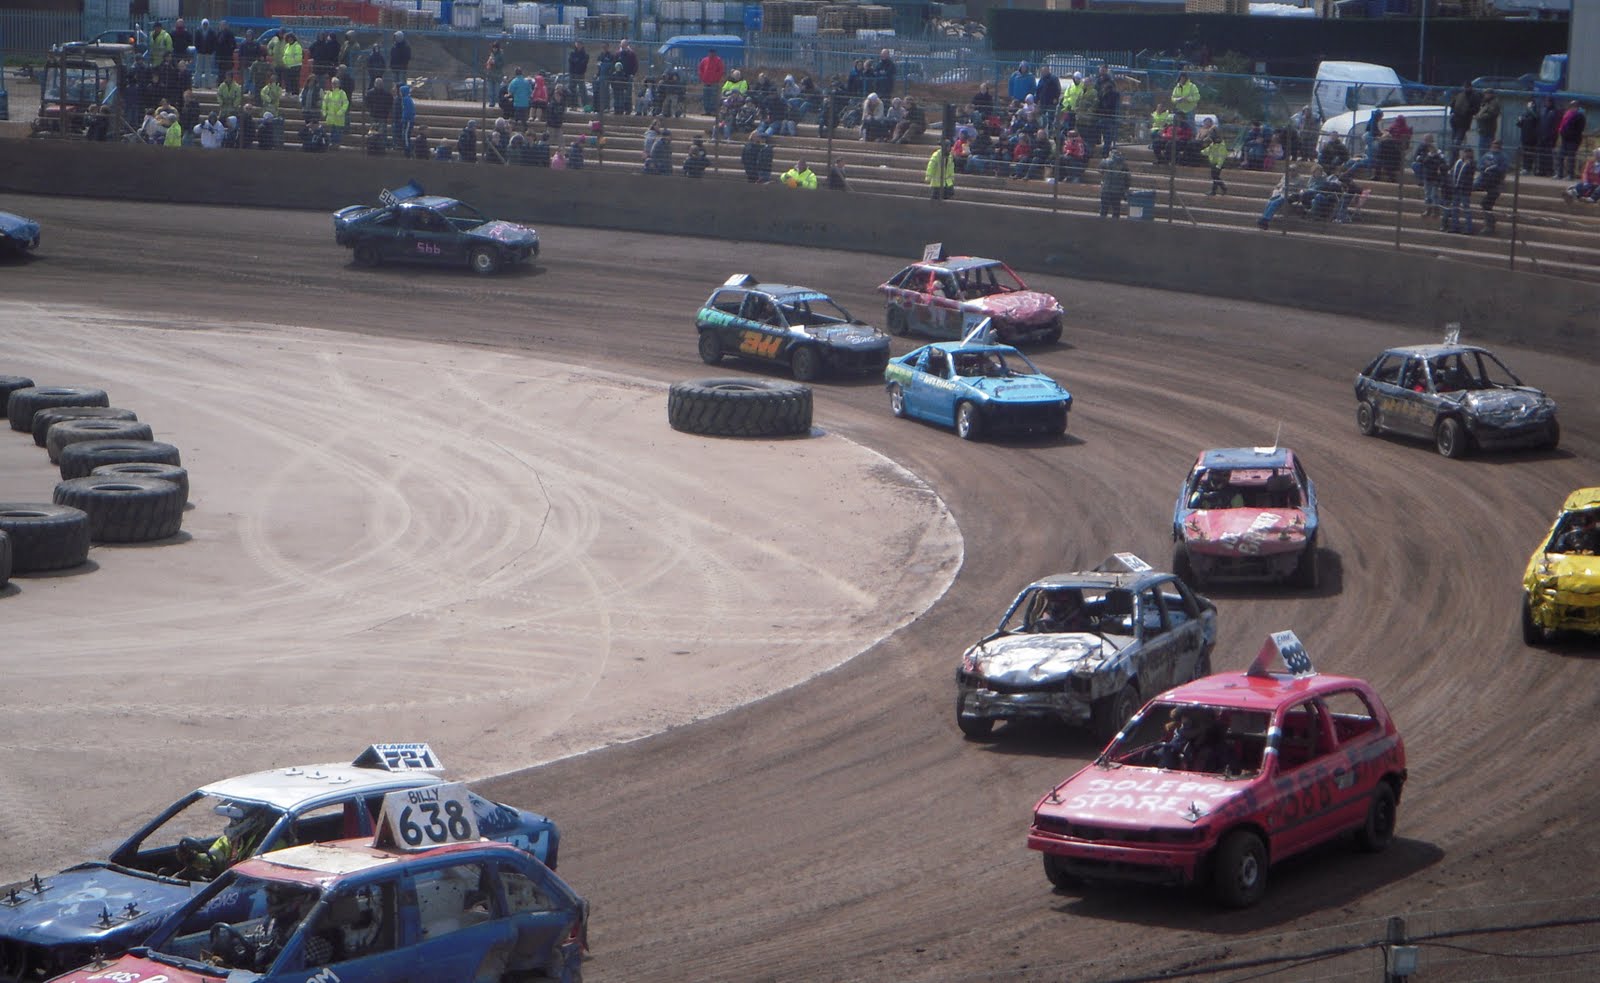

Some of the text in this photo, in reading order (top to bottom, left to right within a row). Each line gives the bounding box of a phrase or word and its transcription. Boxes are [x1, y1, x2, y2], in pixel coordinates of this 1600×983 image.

[383, 750, 435, 768] 721
[408, 788, 439, 804] BILLY
[399, 800, 471, 846] 638
